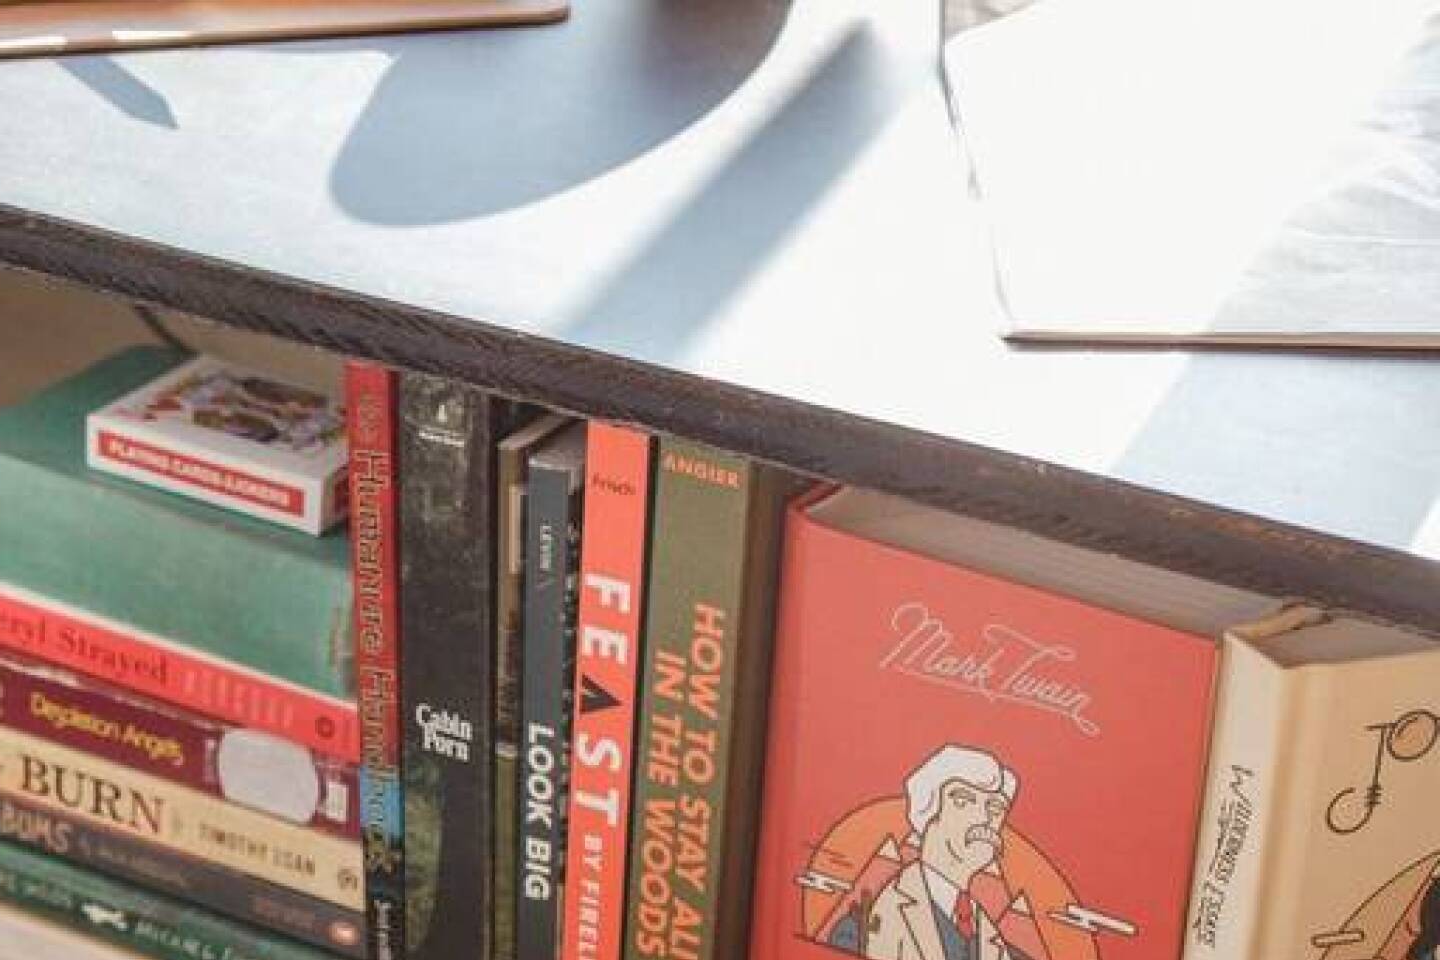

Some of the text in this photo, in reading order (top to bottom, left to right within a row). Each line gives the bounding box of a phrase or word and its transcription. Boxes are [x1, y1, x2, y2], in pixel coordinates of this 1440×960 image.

[663, 452, 740, 489] ANGIER
[59, 626, 169, 690] Strayed
[573, 572, 631, 827] FEAST
[689, 602, 724, 721] HOW
[879, 601, 1095, 720] Mark Twain
[416, 703, 473, 742] Cabin
[681, 730, 719, 783] TO
[20, 752, 165, 836] BURN
[525, 722, 555, 900] LOOK BIG
[636, 649, 687, 957] IN THE WOODS
[1325, 708, 1440, 834] JO
[583, 834, 603, 869] BY
[675, 798, 711, 892] STAY
